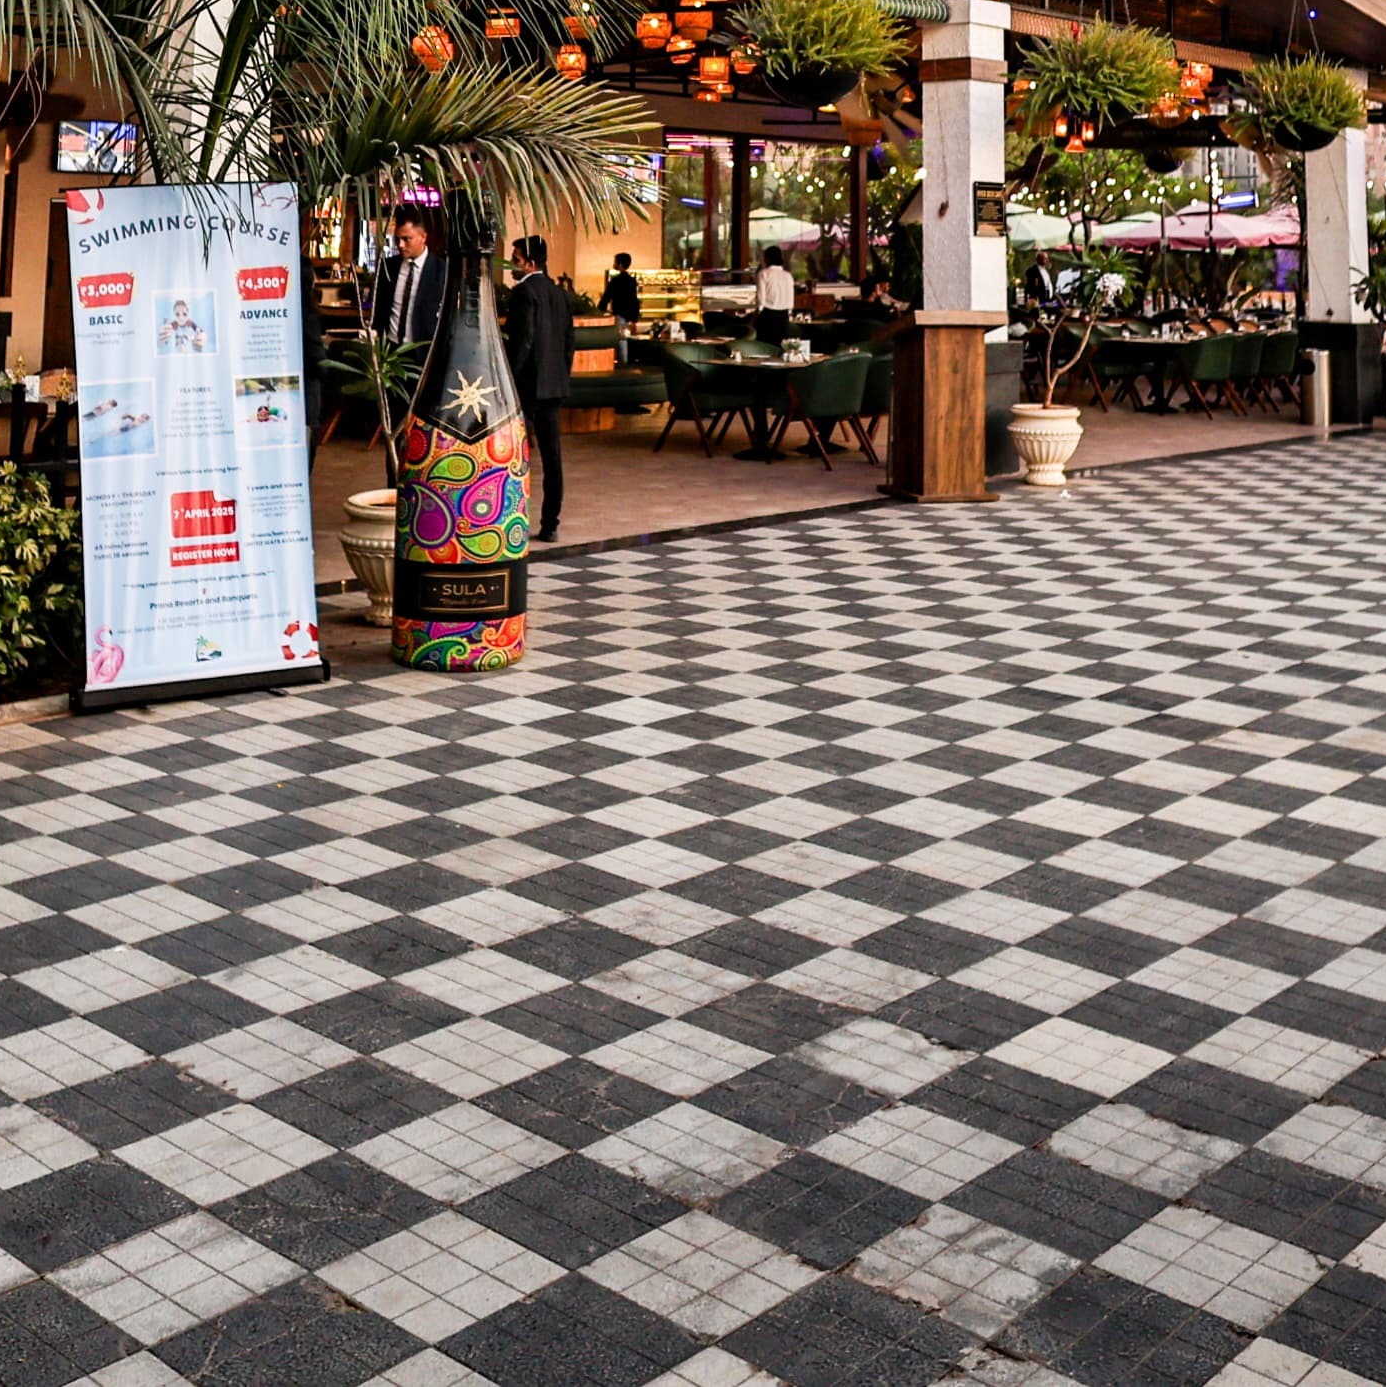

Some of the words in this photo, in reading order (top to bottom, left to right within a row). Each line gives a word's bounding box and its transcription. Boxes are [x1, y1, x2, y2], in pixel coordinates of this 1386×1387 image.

[79, 215, 197, 254] SWIMMING
[207, 216, 291, 246] COURSE
[89, 315, 124, 326] BASIC
[239, 308, 289, 320] ADVANCE
[184, 508, 211, 519] APRIL
[211, 506, 234, 517] 2025
[172, 549, 213, 561] REGISTER
[213, 547, 237, 558] NOW
[442, 583, 486, 596] SULA
